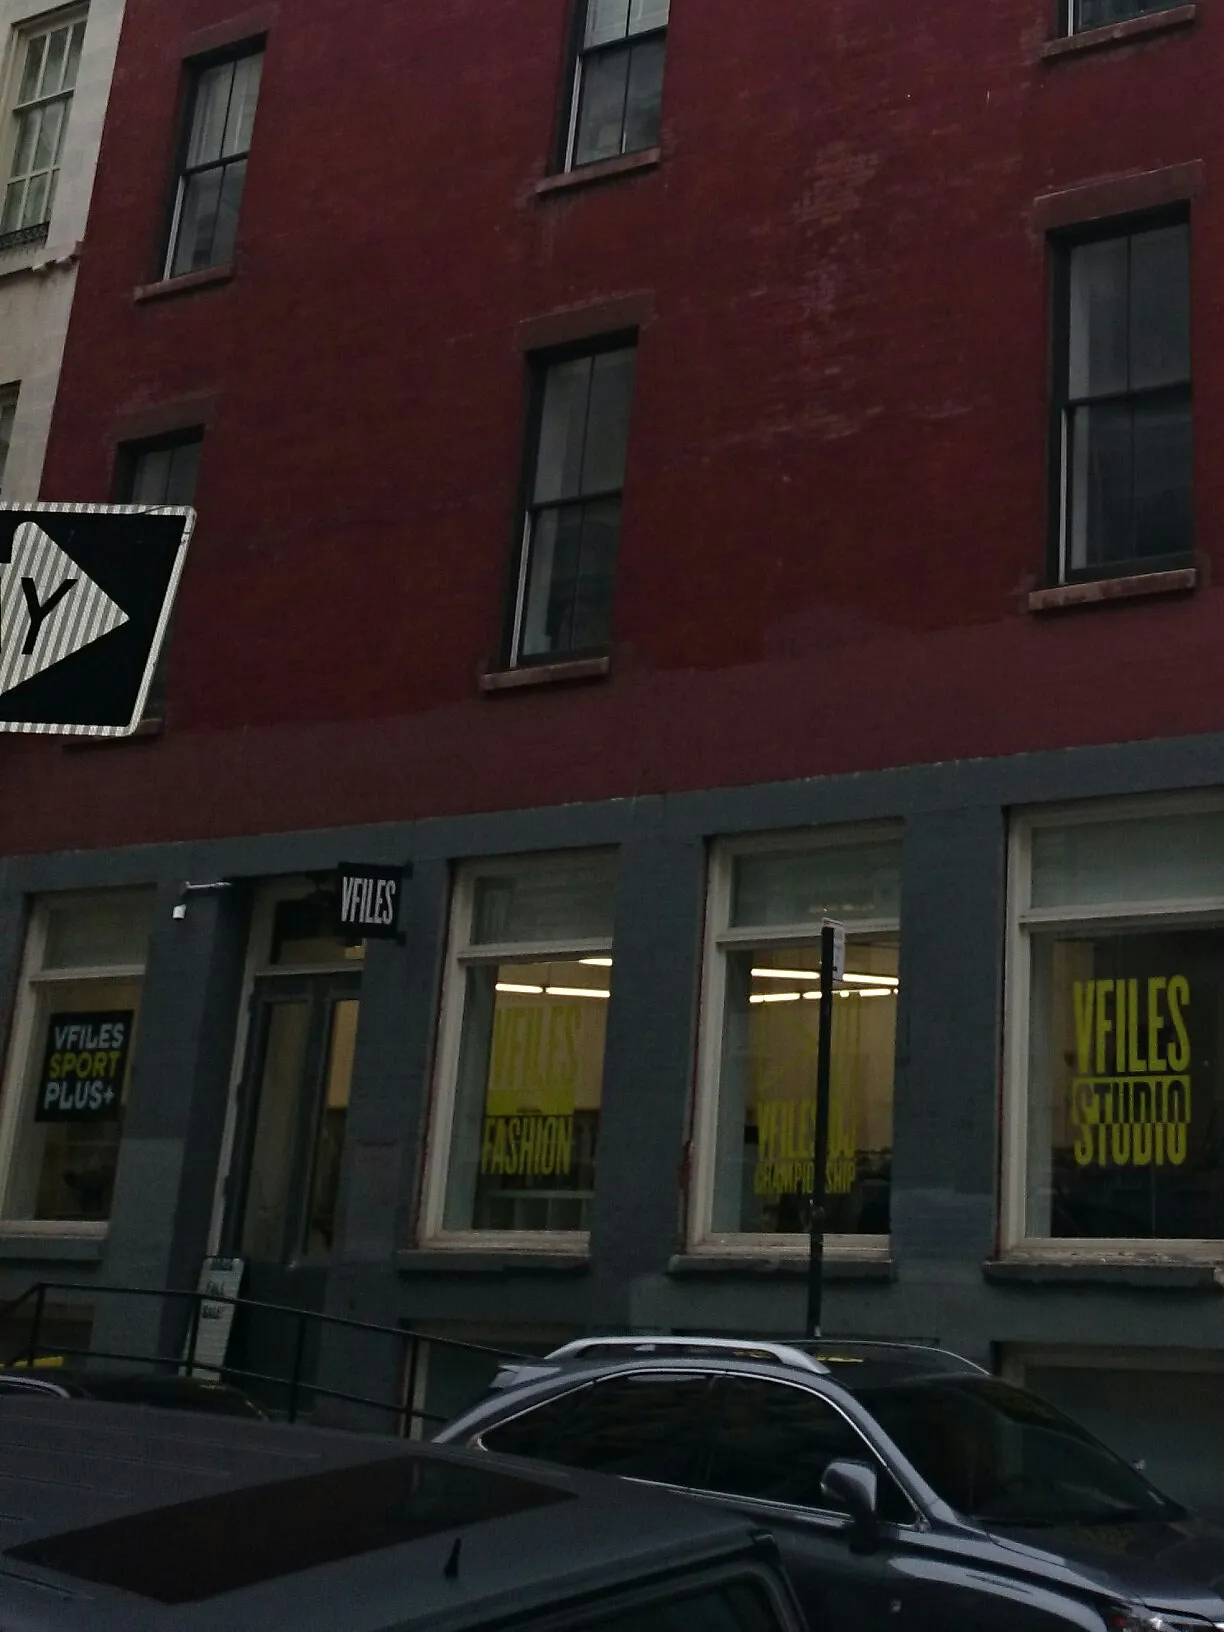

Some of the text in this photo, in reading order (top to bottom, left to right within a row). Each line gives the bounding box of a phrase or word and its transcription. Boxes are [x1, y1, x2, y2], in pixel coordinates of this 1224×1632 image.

[0, 577, 78, 655] Y
[341, 876, 396, 925] VFILES
[54, 1021, 125, 1050] VFILES
[1073, 974, 1191, 1073] VFILES
[47, 1050, 121, 1080] SPORT
[43, 1079, 116, 1111] PLUS+
[482, 1114, 573, 1176] FASHION
[1073, 1078, 1190, 1167] STUDIO
[753, 1160, 857, 1195] CHAMPIOSHIP
